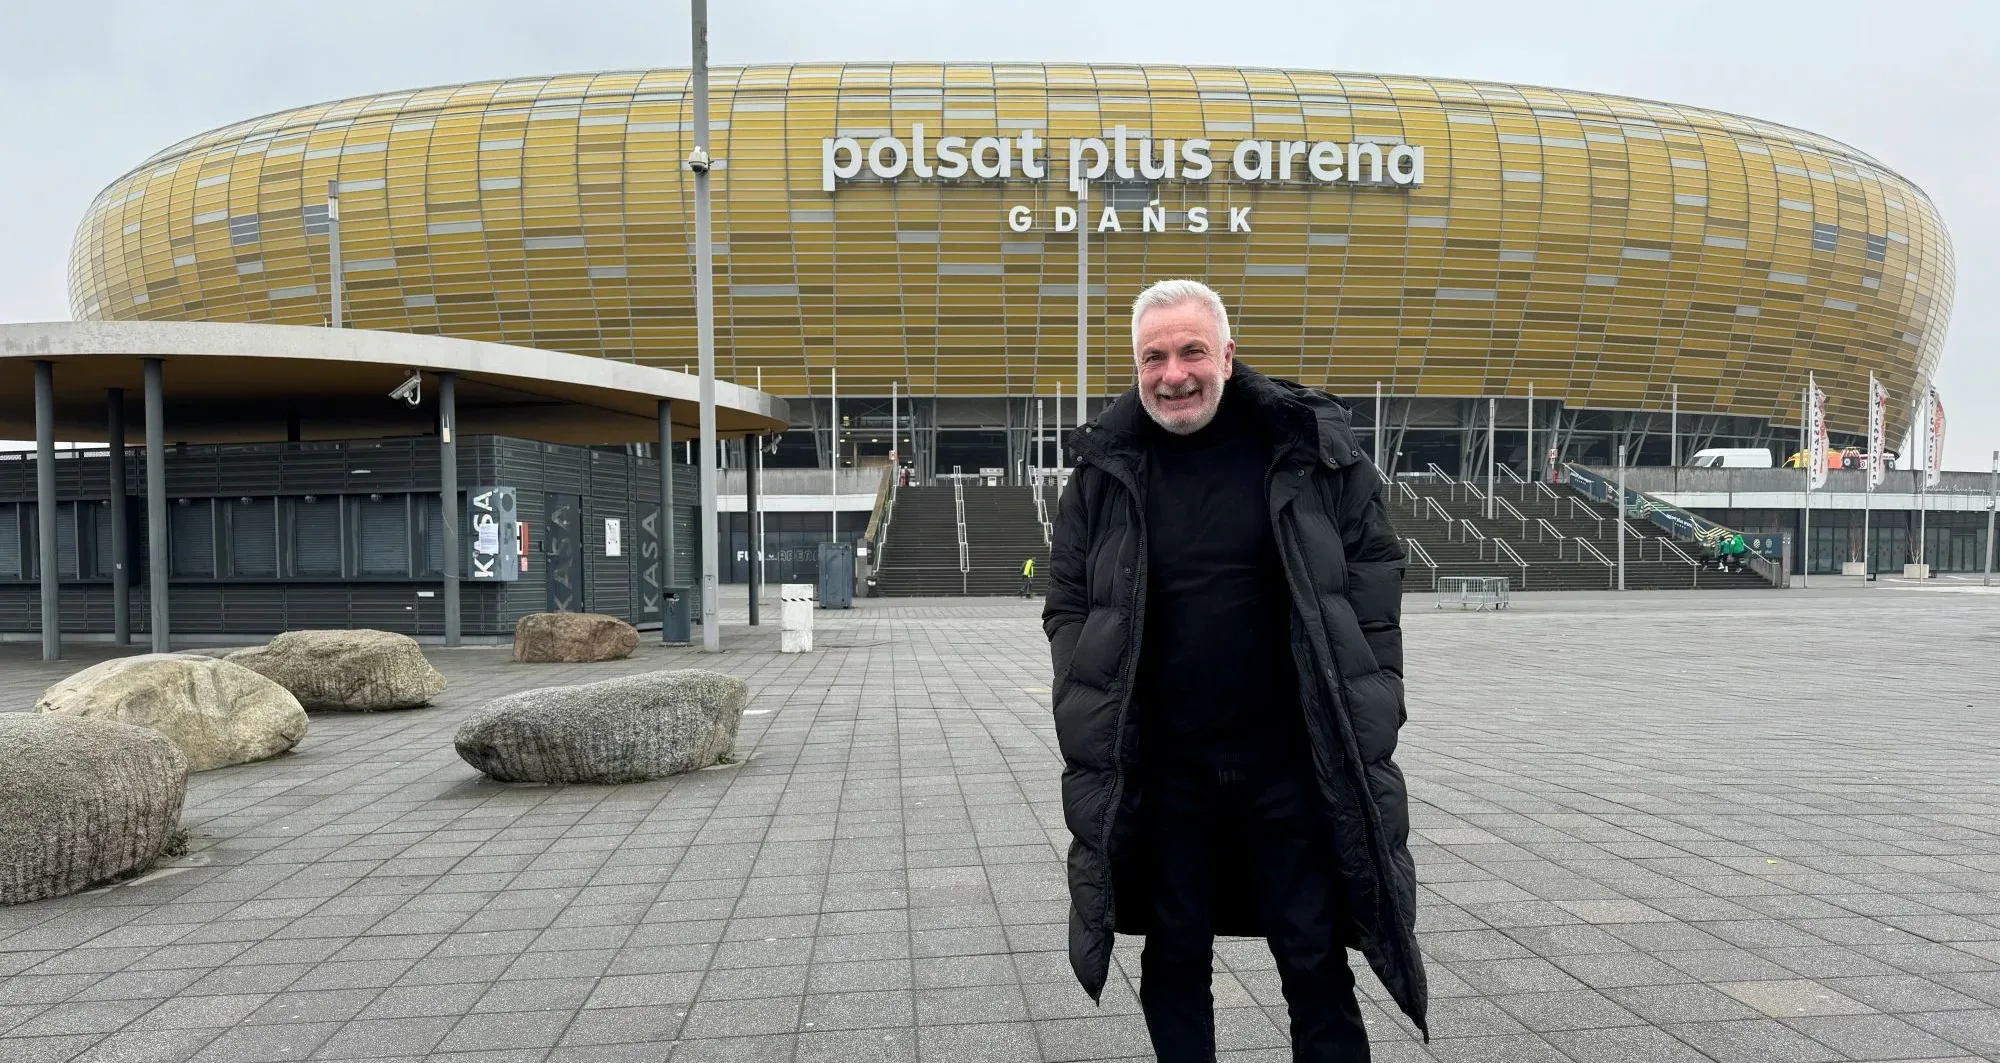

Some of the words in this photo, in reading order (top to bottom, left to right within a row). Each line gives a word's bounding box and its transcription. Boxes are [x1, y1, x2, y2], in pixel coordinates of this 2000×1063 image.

[823, 123, 1045, 192] polsat
[1069, 124, 1213, 192] plus
[1233, 139, 1425, 185] arena
[1008, 199, 1252, 233] GDAŃSK
[642, 505, 660, 613] KASA
